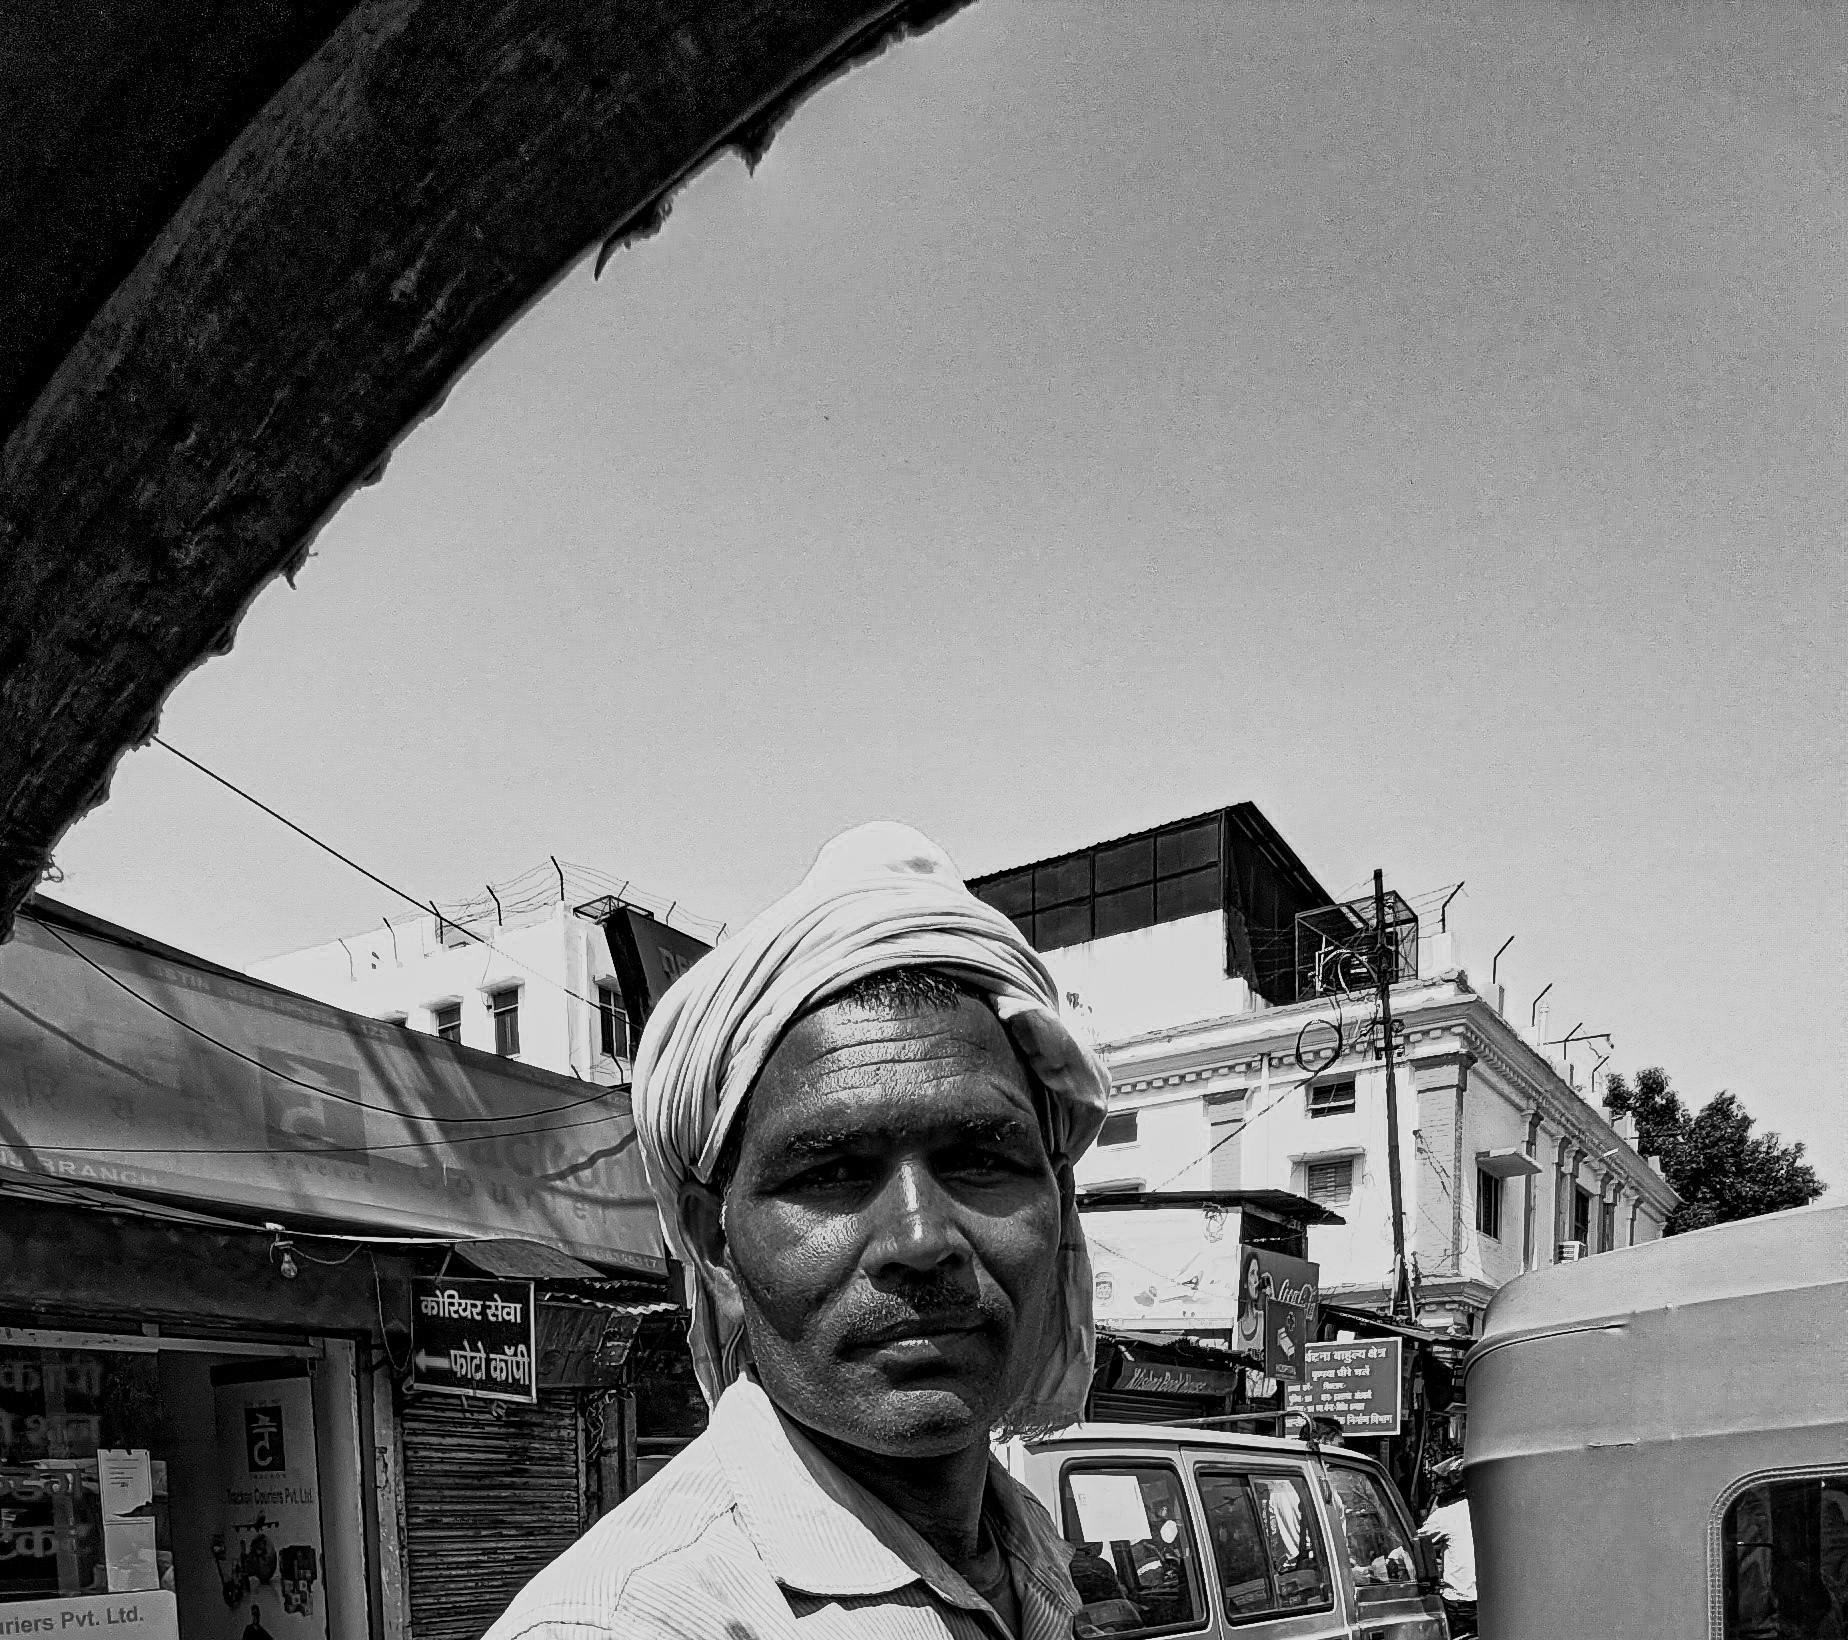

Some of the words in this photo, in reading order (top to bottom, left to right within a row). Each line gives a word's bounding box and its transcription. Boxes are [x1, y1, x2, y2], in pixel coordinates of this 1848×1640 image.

[420, 1290, 483, 1321] कोरियर
[485, 1293, 522, 1324] सेवा
[450, 1339, 486, 1381] फोटो
[489, 1344, 530, 1386] कॉपी
[1305, 1350, 1331, 1363] र्घटना
[60, 1610, 100, 1630] Pvt.
[106, 1605, 144, 1625] Ltd.
